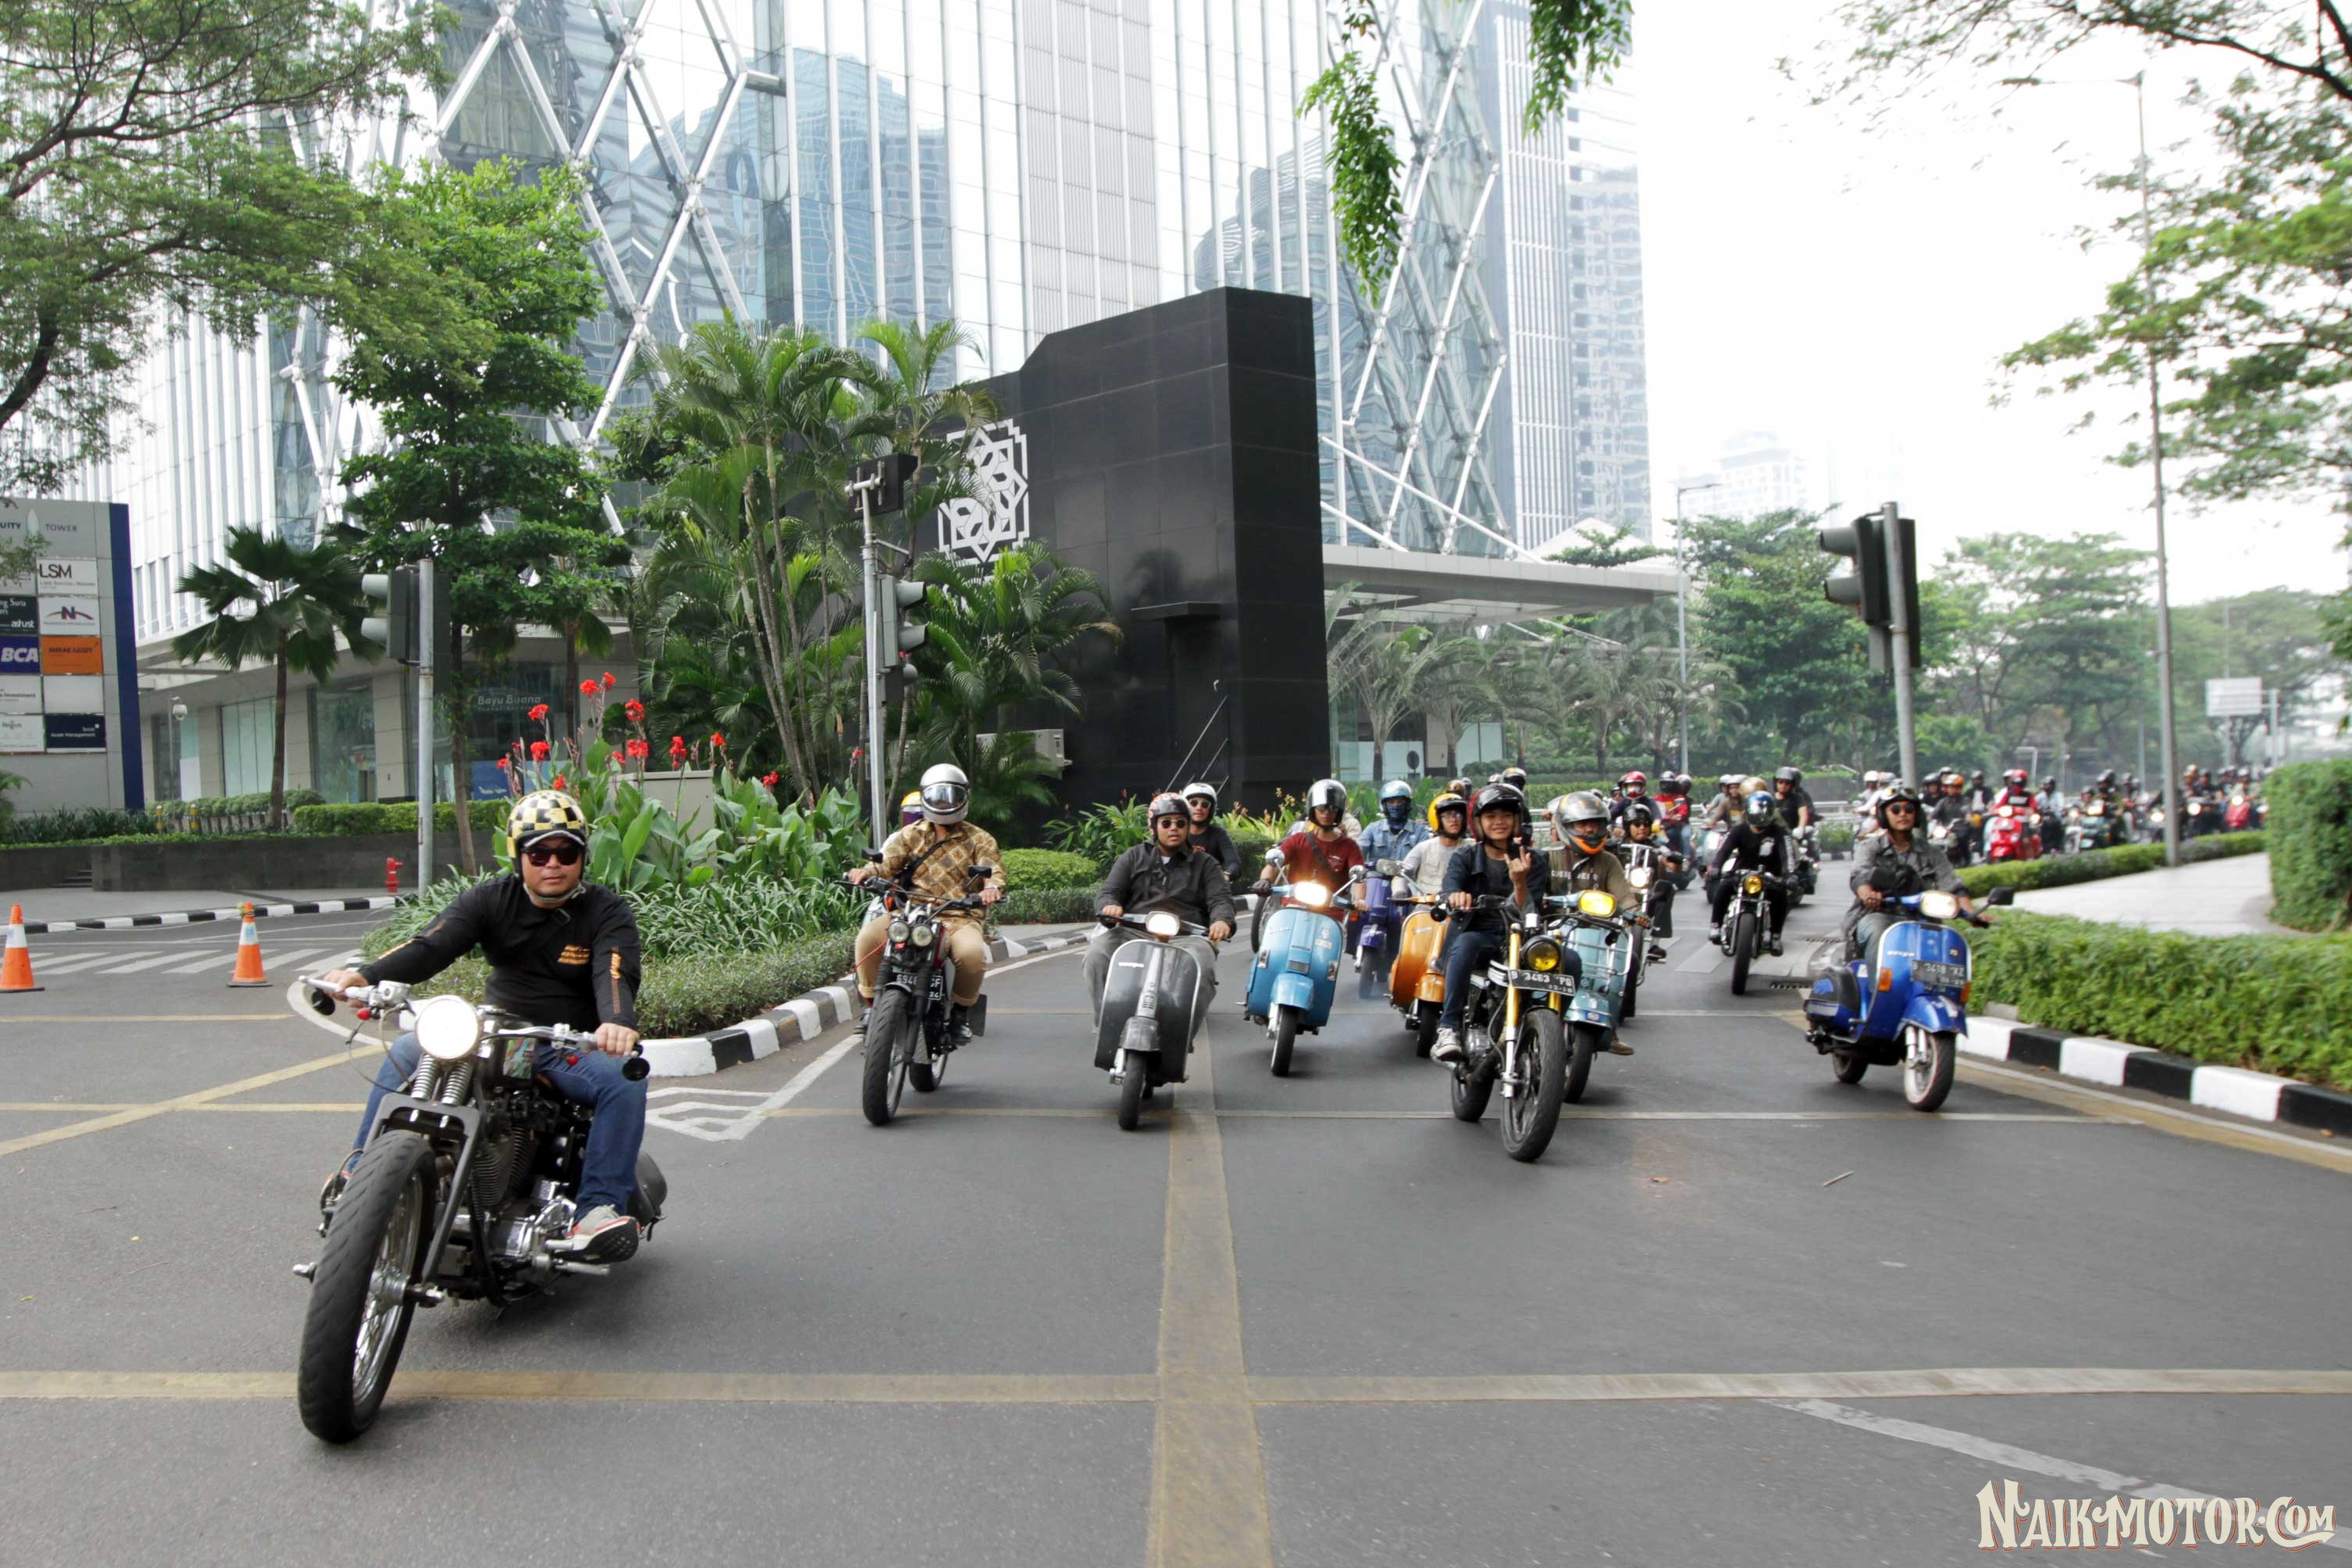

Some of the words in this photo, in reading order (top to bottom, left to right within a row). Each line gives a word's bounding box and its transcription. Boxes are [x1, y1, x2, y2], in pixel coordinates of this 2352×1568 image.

[39, 563, 72, 579] LSM
[1, 647, 39, 662] BCA
[1511, 971, 1518, 979] B
